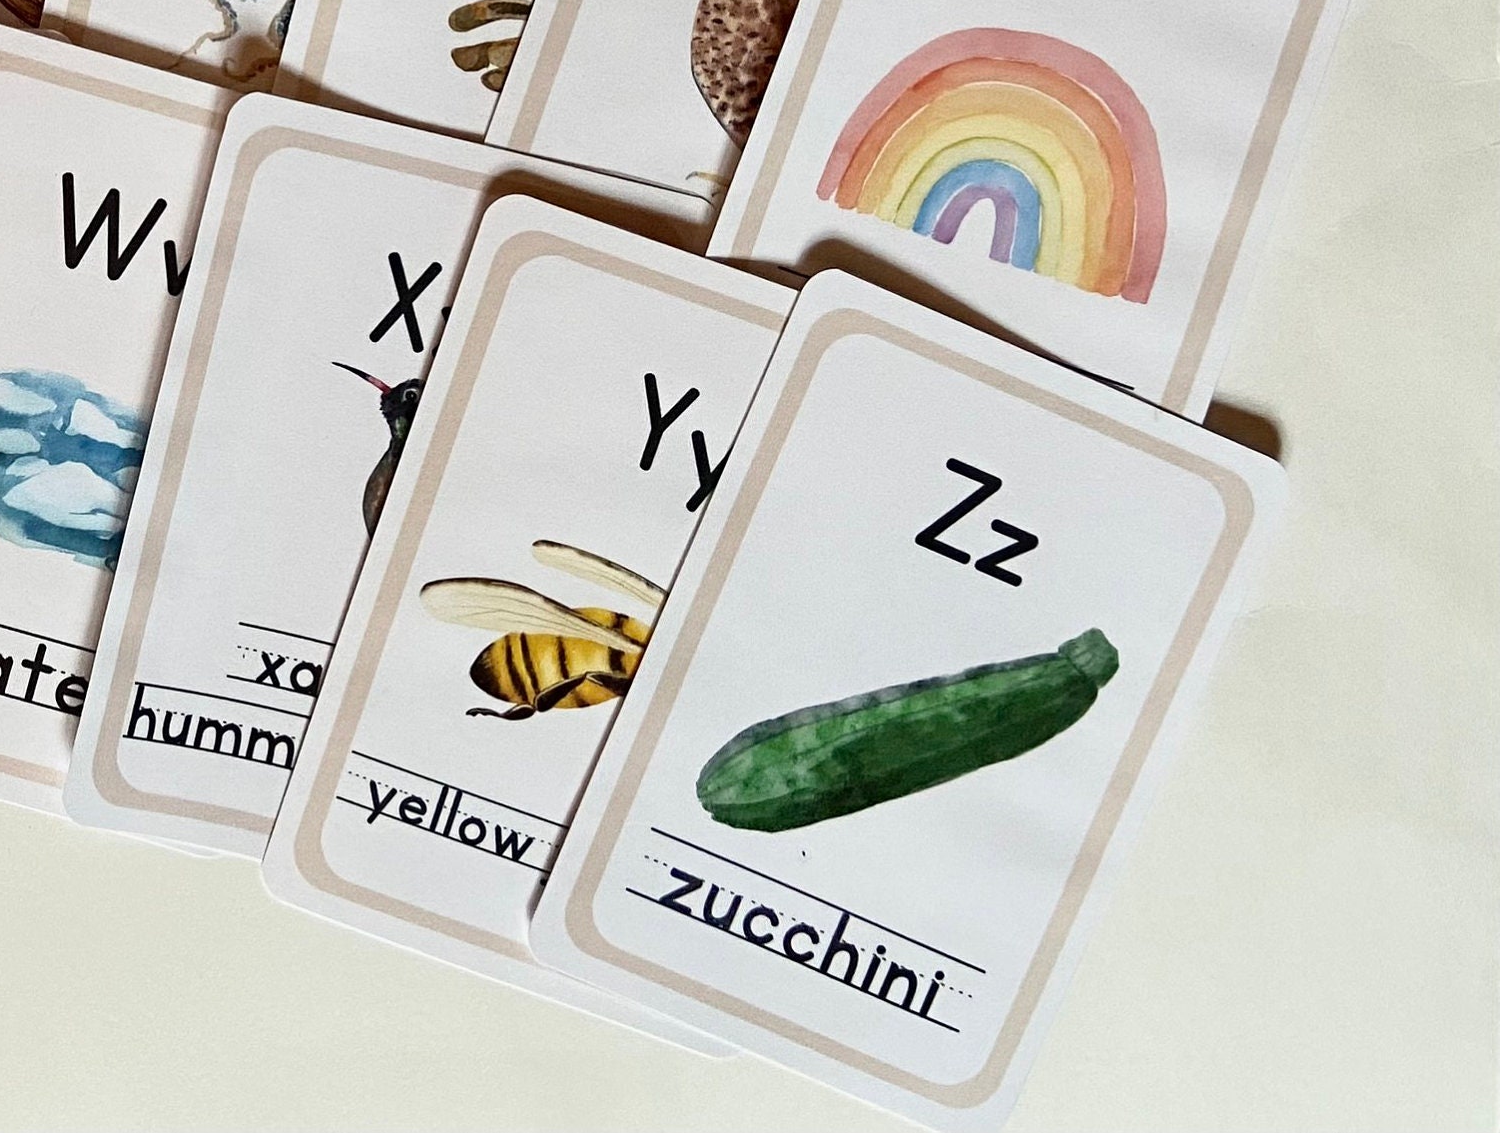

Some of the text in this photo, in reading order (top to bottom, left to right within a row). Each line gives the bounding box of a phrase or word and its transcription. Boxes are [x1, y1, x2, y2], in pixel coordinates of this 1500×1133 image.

[369, 252, 449, 355] X
[640, 372, 729, 512] Yy
[915, 458, 1038, 586] Zz
[126, 684, 296, 770] humm
[366, 779, 534, 862] yellow
[658, 867, 945, 1017] zucchini
